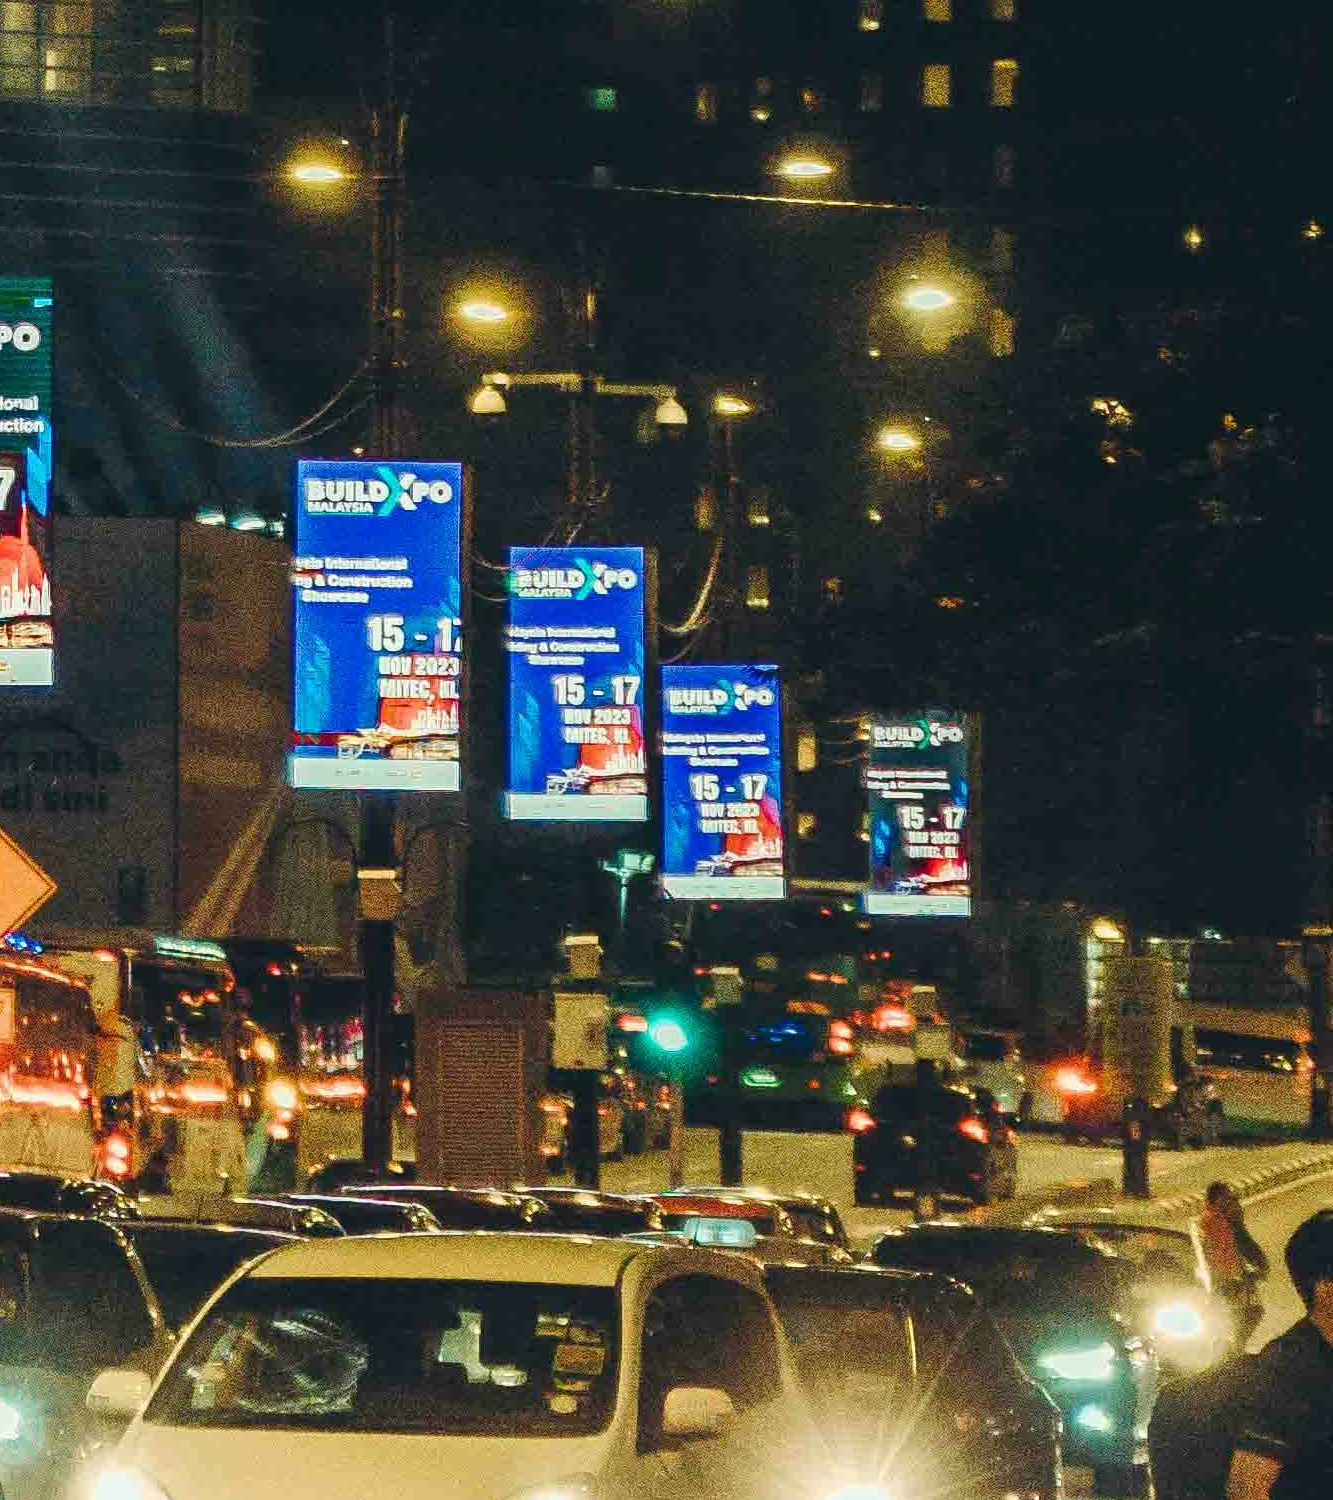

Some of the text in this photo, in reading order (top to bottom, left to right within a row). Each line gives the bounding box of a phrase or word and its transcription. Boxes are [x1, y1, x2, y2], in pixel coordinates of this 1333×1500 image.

[366, 614, 405, 652] 15
[379, 656, 461, 676] NOV 2023
[552, 675, 585, 706] 15
[612, 675, 641, 706] 17
[690, 774, 720, 801] 15
[741, 774, 768, 801] 17
[900, 807, 925, 829] 15
[942, 807, 965, 829] 17
